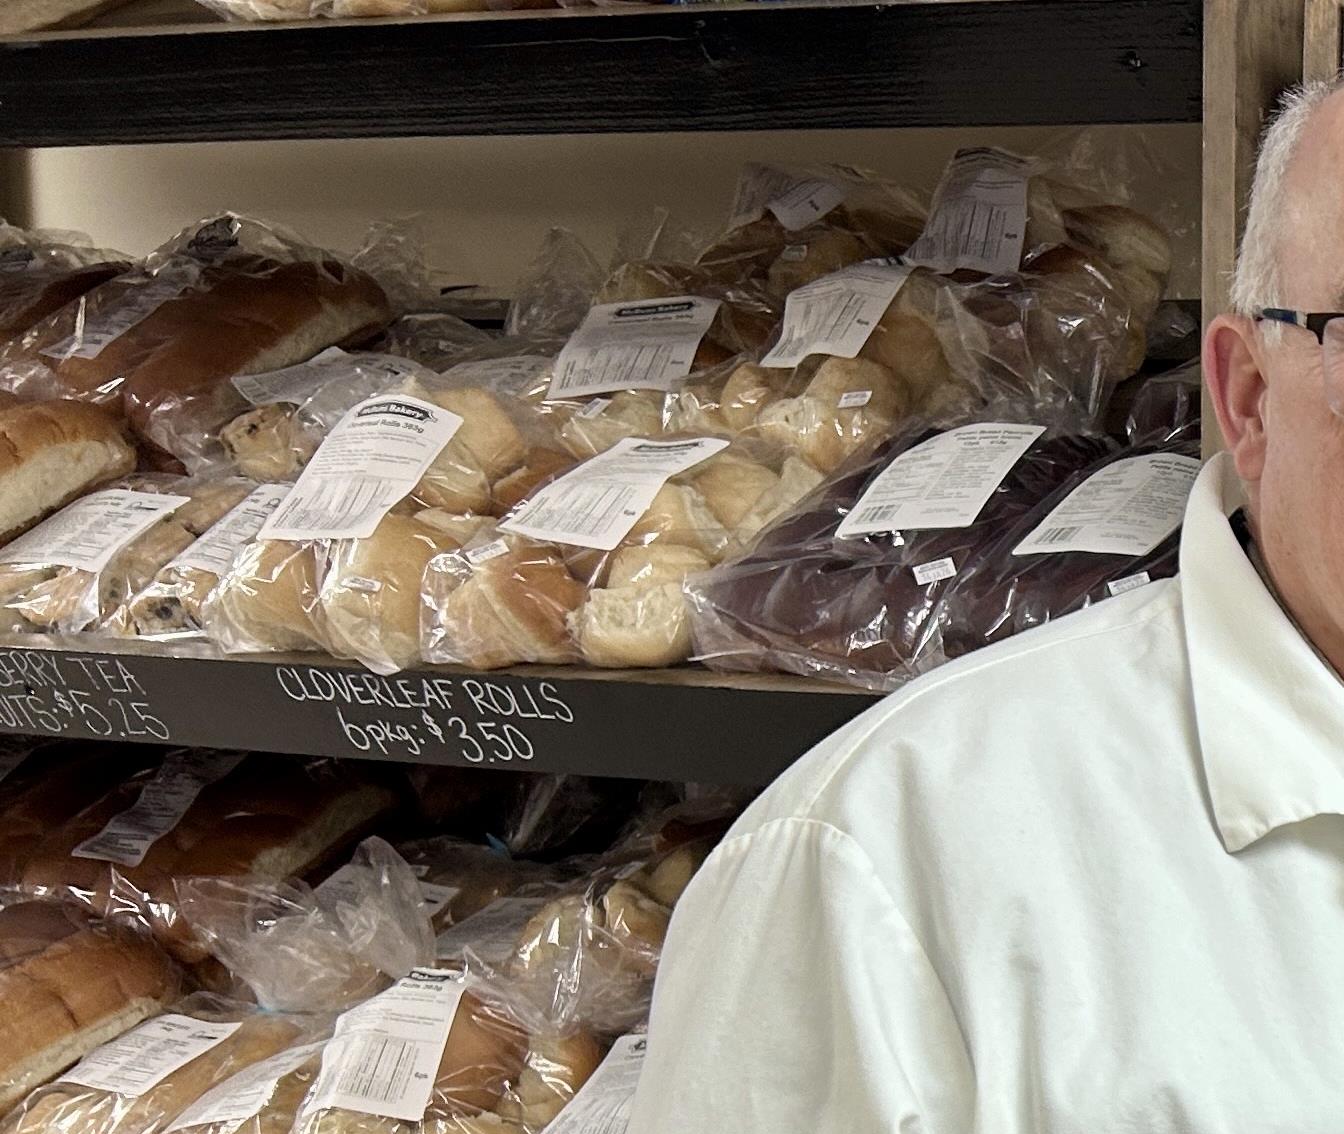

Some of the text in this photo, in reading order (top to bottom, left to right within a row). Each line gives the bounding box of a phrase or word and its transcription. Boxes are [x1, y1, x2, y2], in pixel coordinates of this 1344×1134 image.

[65, 656, 147, 697] TEA
[276, 665, 575, 724] CLOVERLEAF ROLLS
[54, 688, 171, 741] $5.25
[422, 708, 535, 765] $3.50
